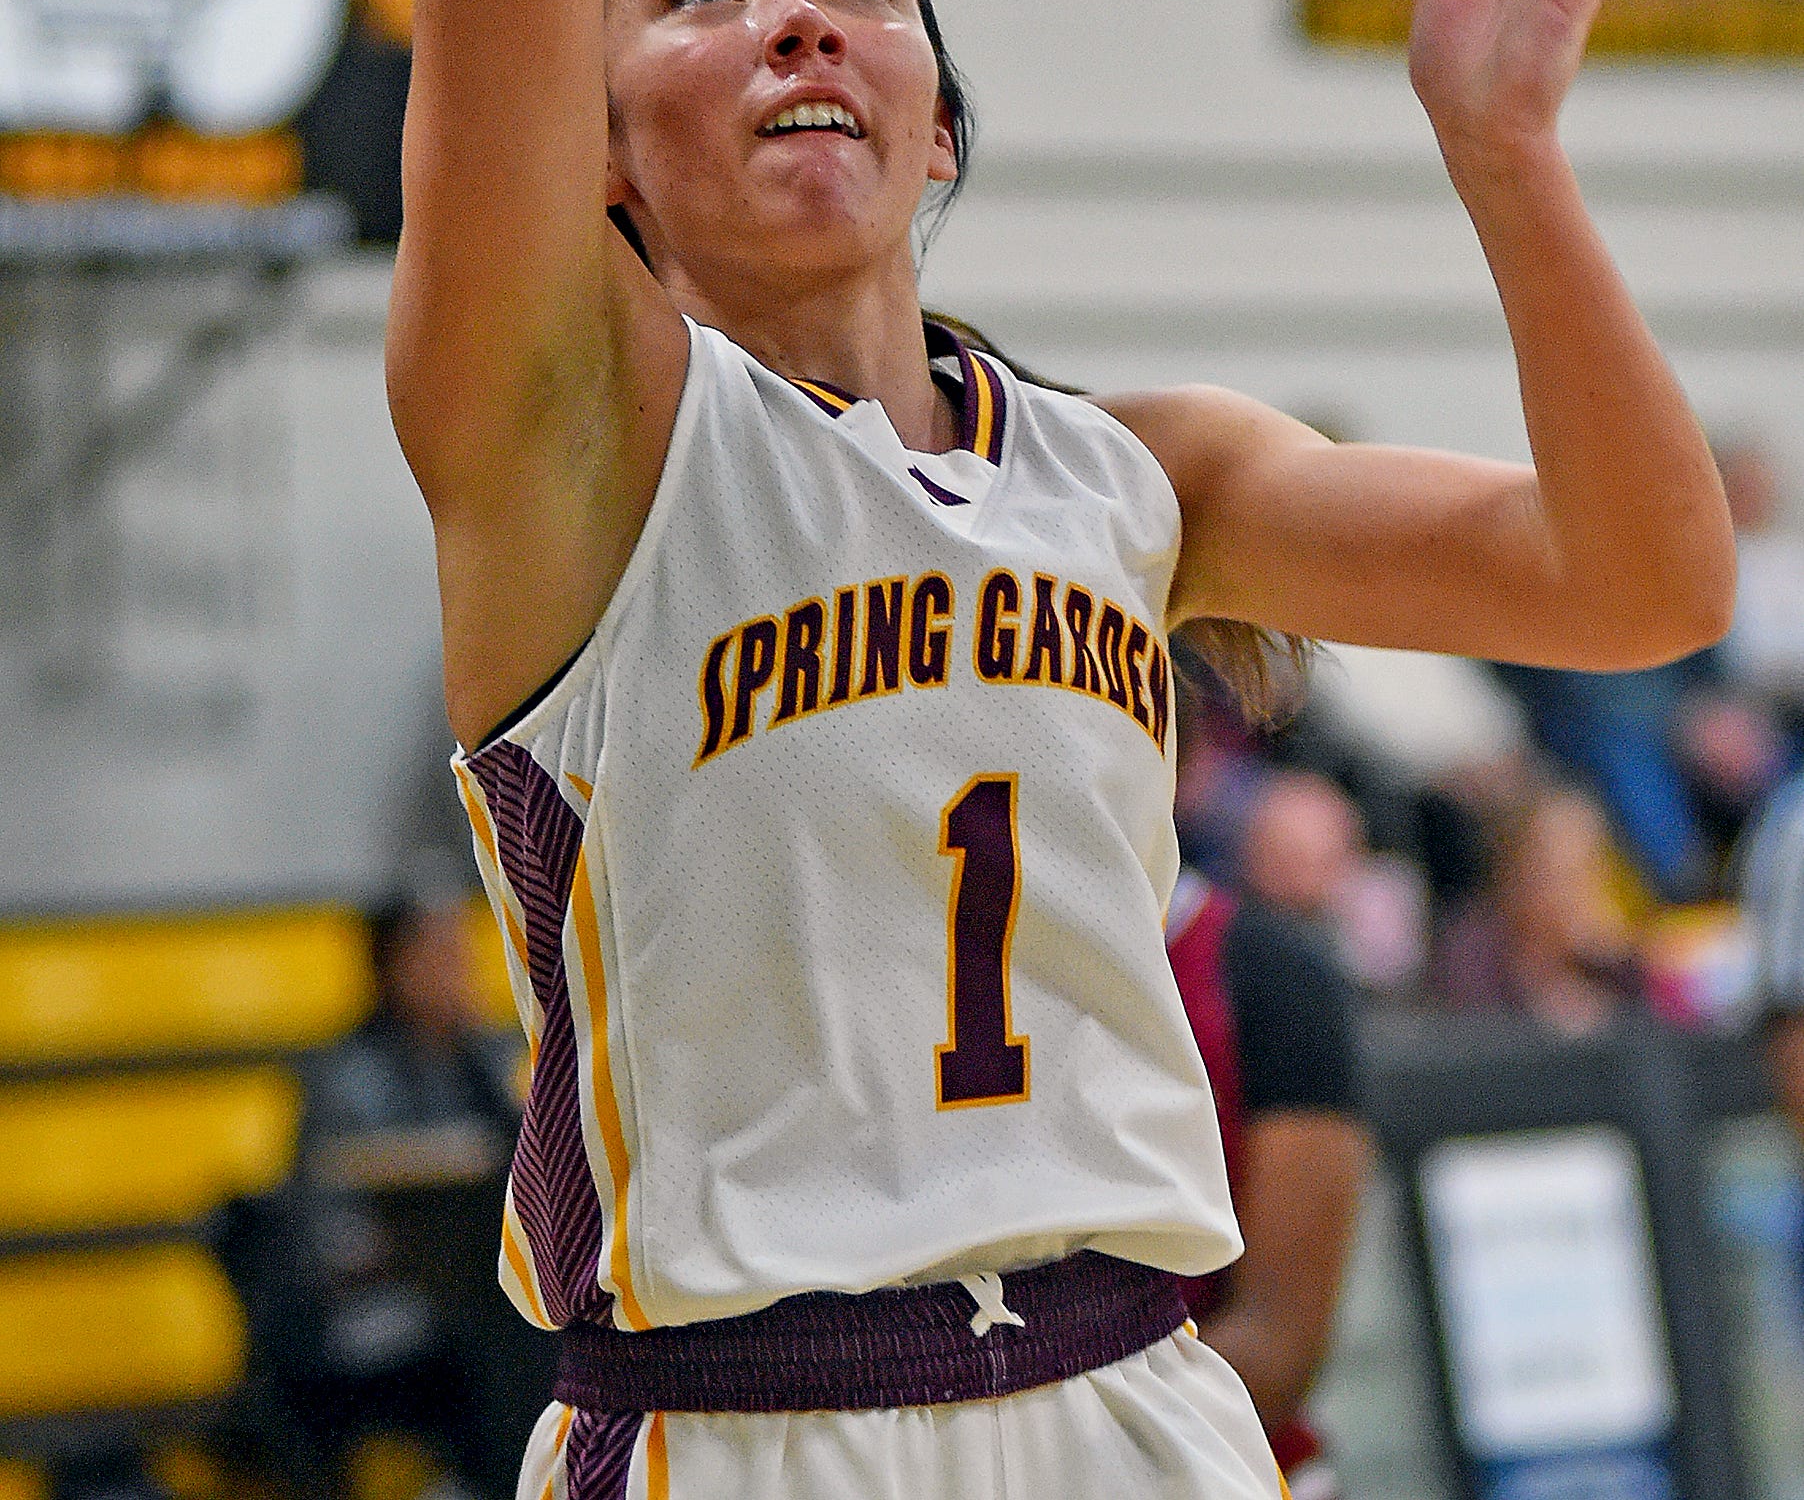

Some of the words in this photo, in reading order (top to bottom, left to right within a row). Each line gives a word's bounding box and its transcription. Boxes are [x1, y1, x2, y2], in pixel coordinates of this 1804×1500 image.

[691, 569, 956, 771] SPRING
[973, 567, 1170, 762] GARDEN
[933, 772, 1031, 1112] 1
